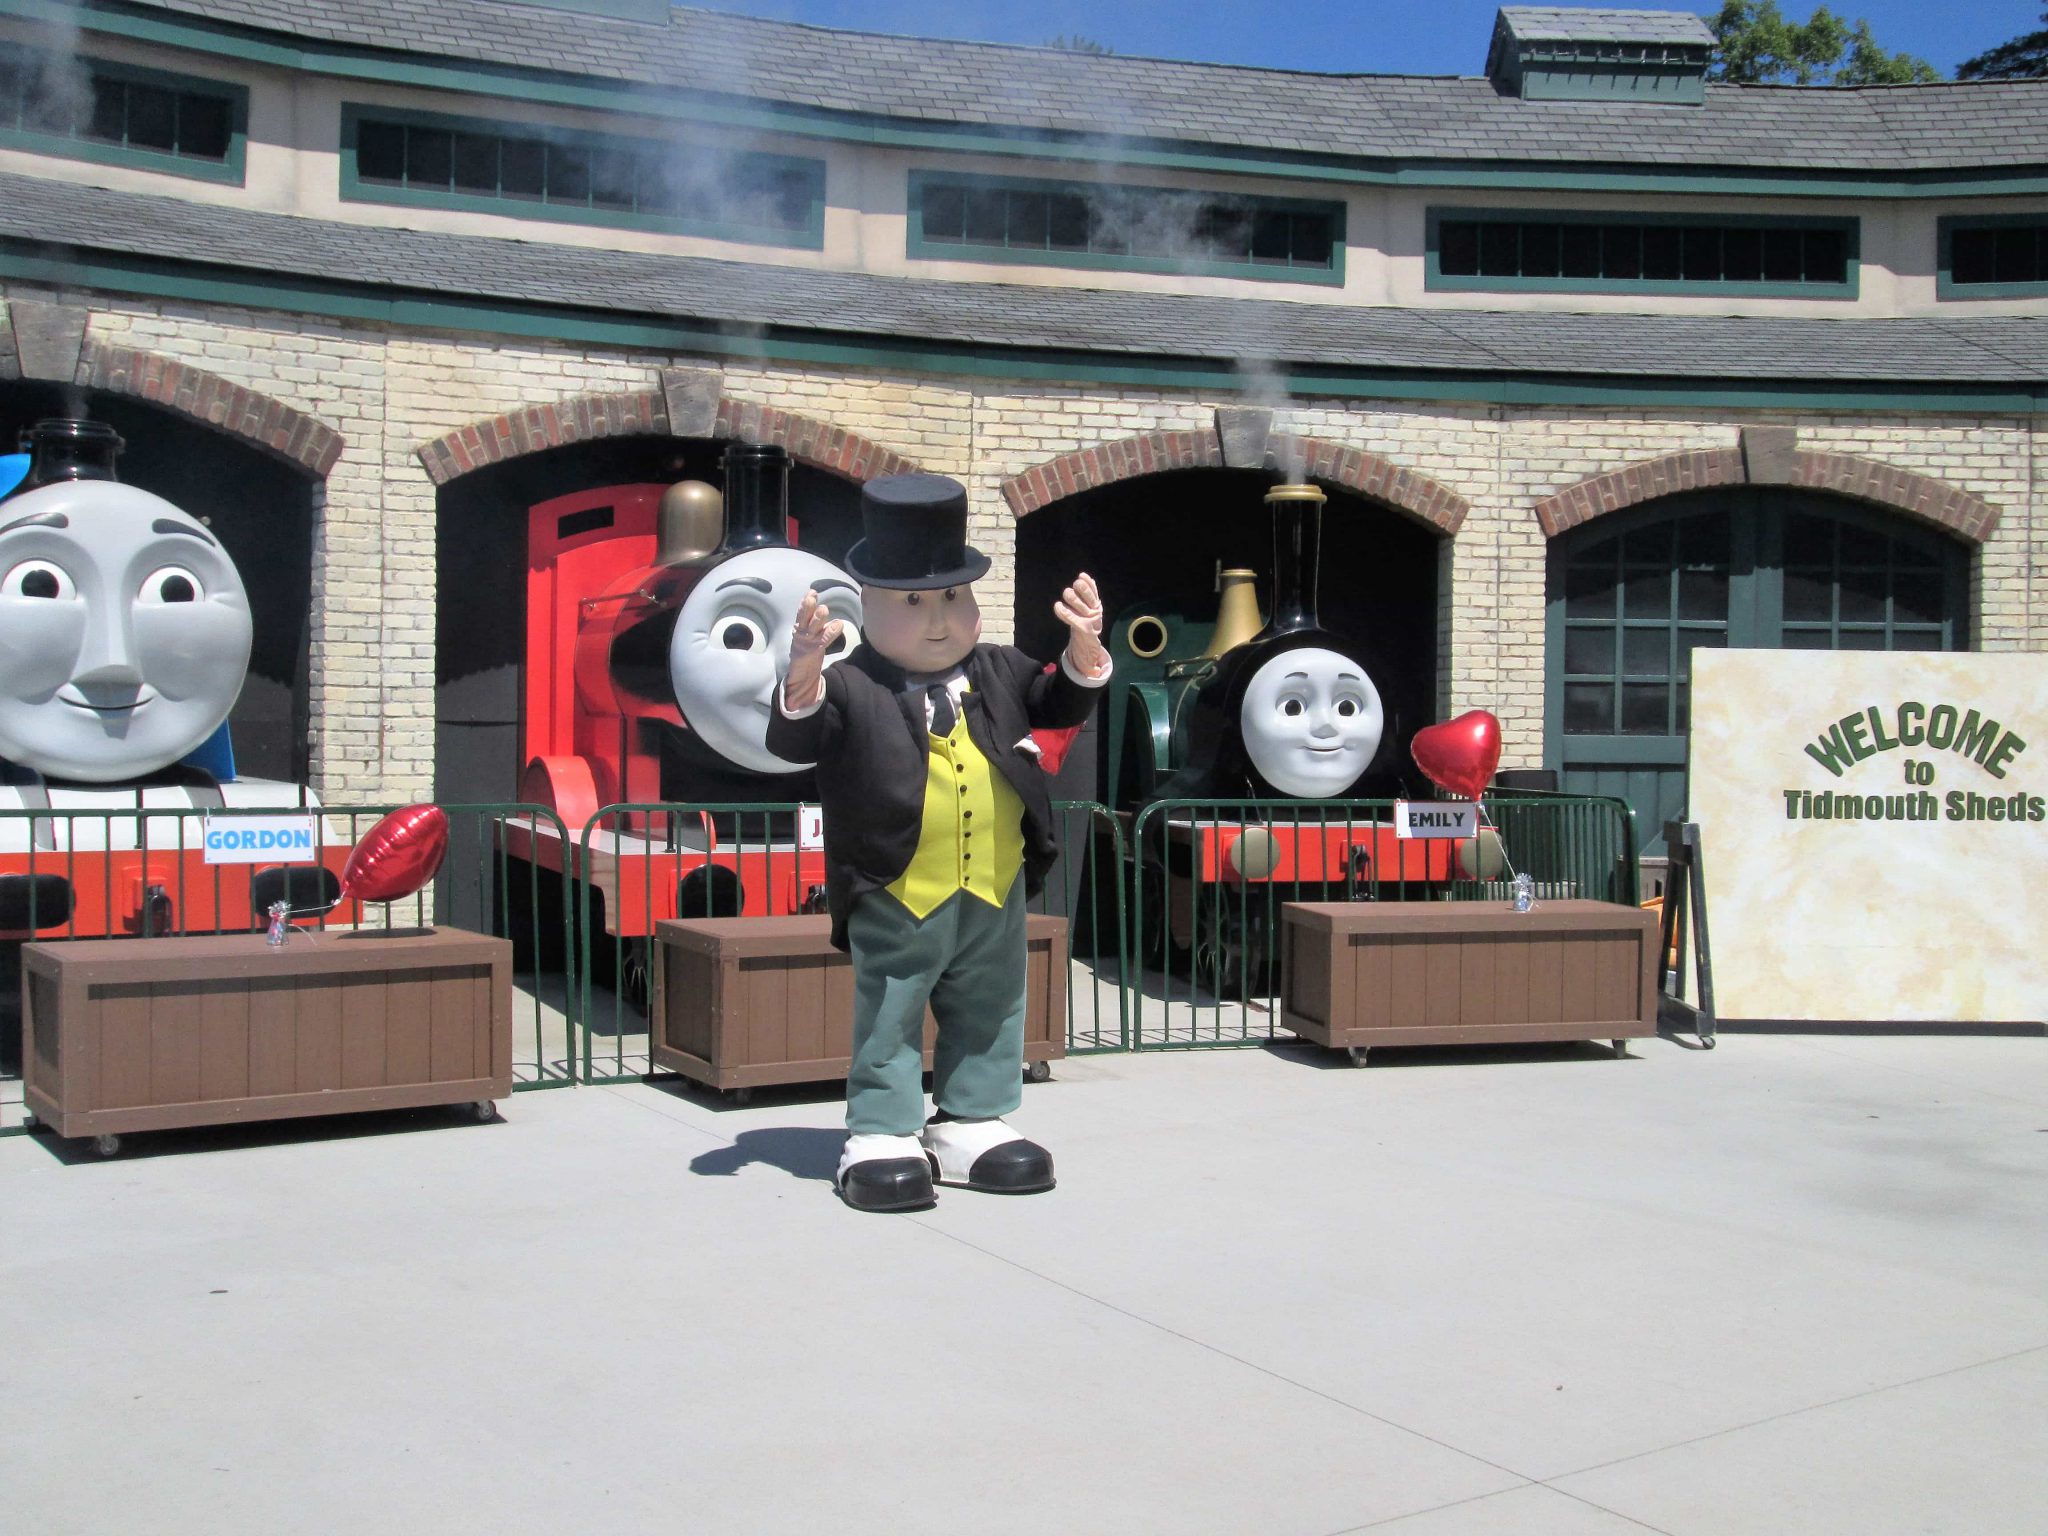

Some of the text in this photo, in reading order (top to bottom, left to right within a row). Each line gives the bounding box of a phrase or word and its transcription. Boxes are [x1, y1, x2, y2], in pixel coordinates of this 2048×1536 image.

[1804, 701, 2027, 780] WELCOME
[1903, 758, 1935, 786] to
[1408, 812, 1466, 827] EMILY
[1783, 789, 2046, 822] Tidmouth Sheds
[206, 829, 311, 849] GORDON
